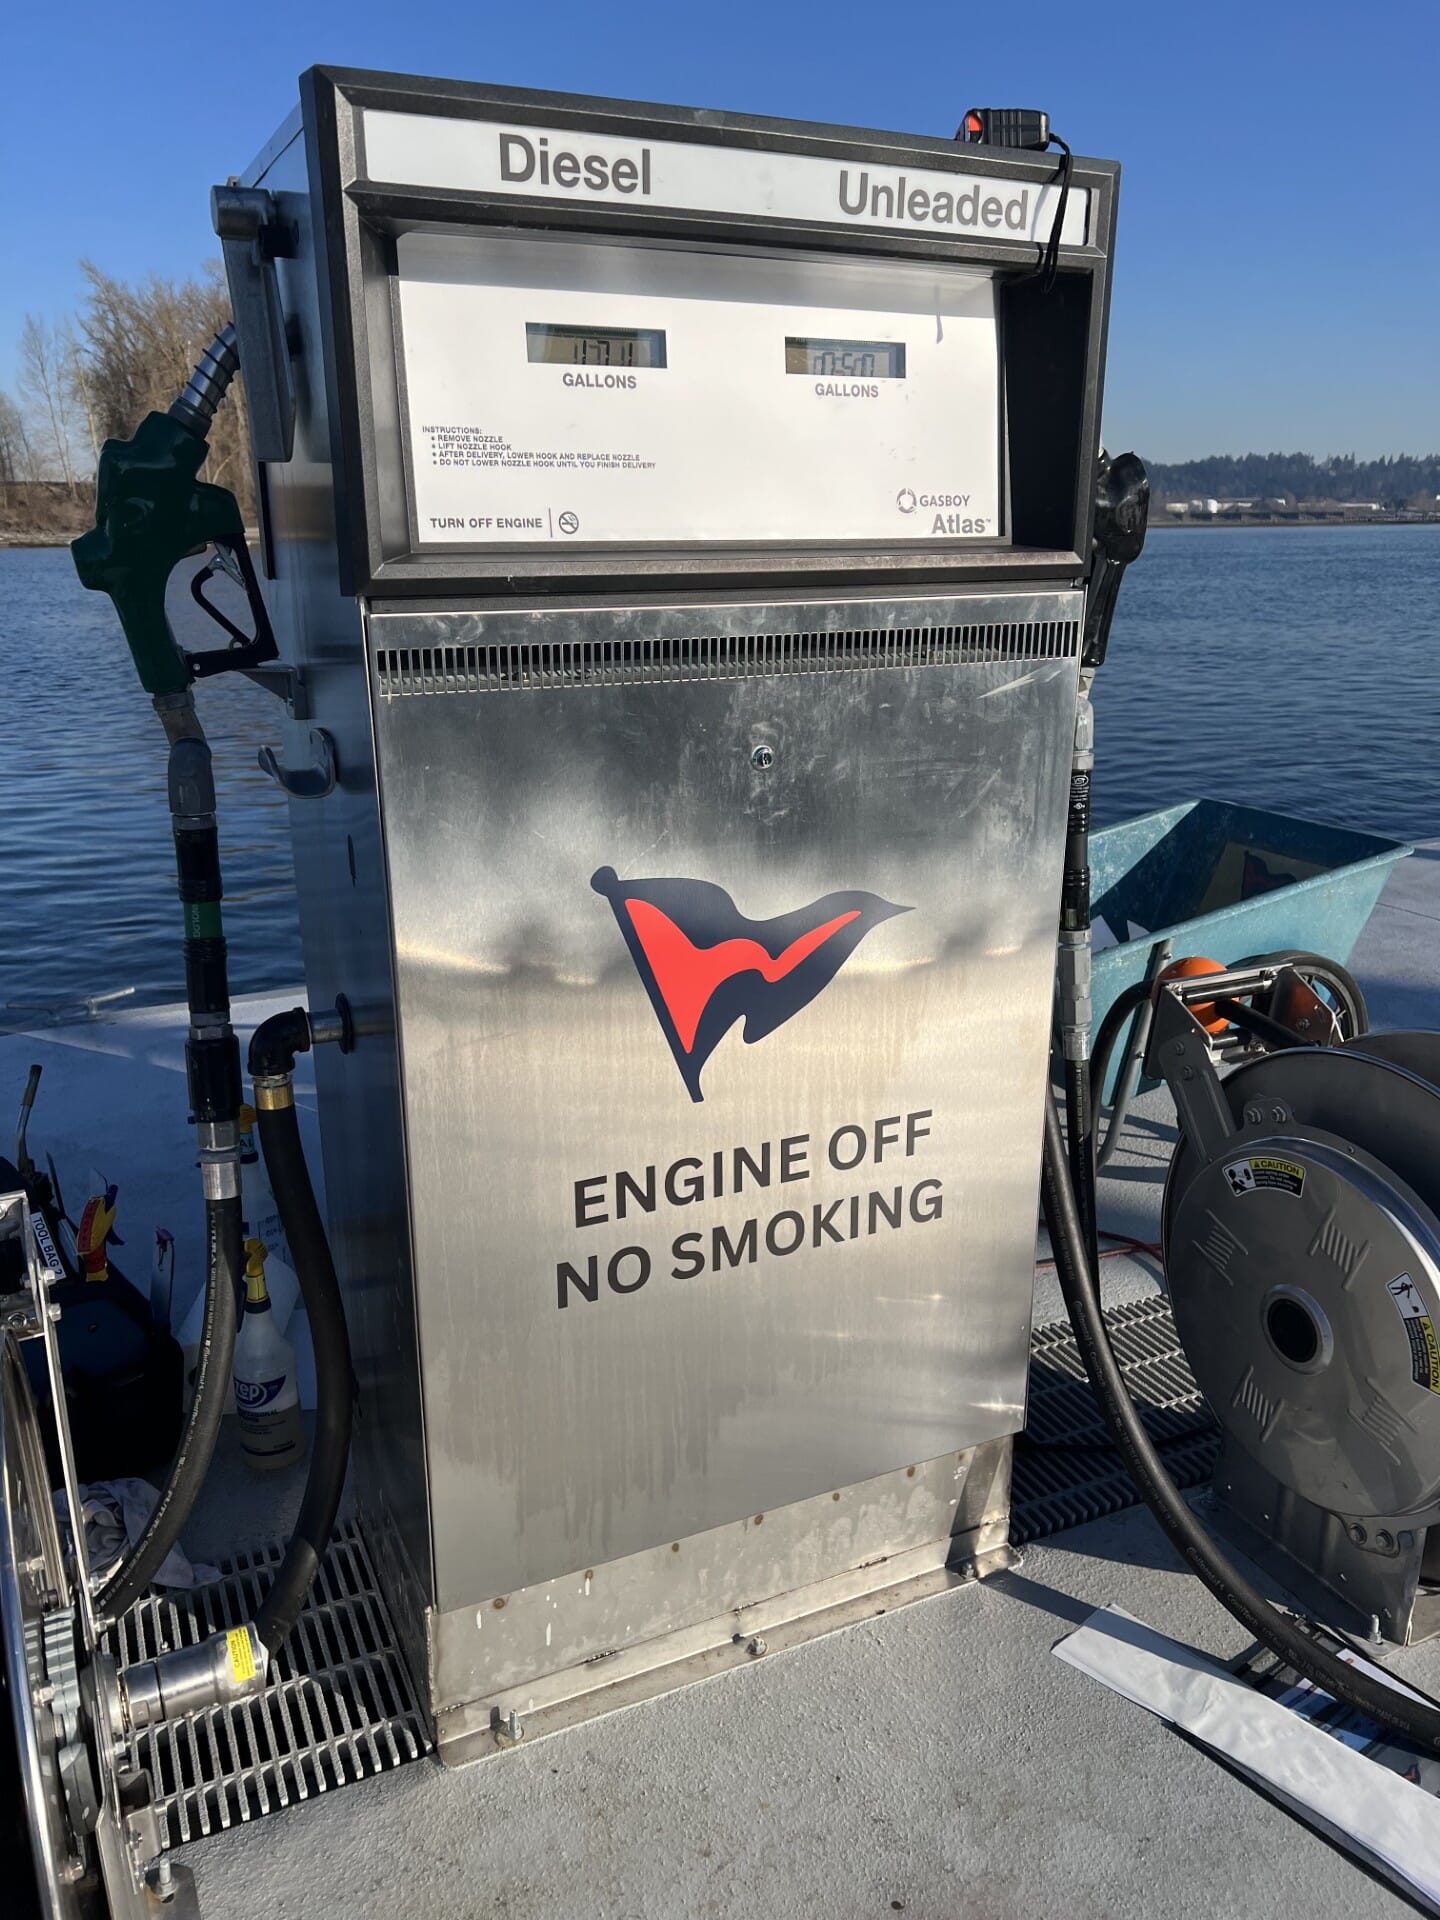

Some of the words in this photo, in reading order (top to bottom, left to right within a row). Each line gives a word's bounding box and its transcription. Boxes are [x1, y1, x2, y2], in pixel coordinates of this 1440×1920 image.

[499, 132, 651, 195] Diesel
[838, 169, 1029, 231] Unleaded
[562, 372, 637, 389] GALLONS
[815, 383, 879, 398] GALLONS
[422, 425, 482, 434] INSTRUCTIONS:
[437, 434, 471, 442] REMOVE
[473, 435, 503, 443] NOZZLE
[456, 443, 488, 451] NOZZLE
[438, 450, 464, 458] AFTER
[536, 452, 558, 460] HOOK
[576, 453, 611, 461] REPLACE
[471, 459, 499, 467] LOWER
[533, 460, 555, 468] HOOK
[919, 494, 971, 508] GASBOY
[429, 517, 465, 529] TURN
[468, 517, 493, 529] OFF
[496, 518, 543, 529] ENGINE
[574, 1134, 810, 1229] ENGINE
[828, 1109, 933, 1171] OFF
[1261, 1160, 1300, 1176] CAUTION
[33, 1216, 48, 1244] TOOL
[43, 1245, 59, 1268] BAG
[556, 1245, 652, 1310] NO
[670, 1178, 944, 1281] SMOKING
[1426, 1334, 1440, 1389] CAUTION
